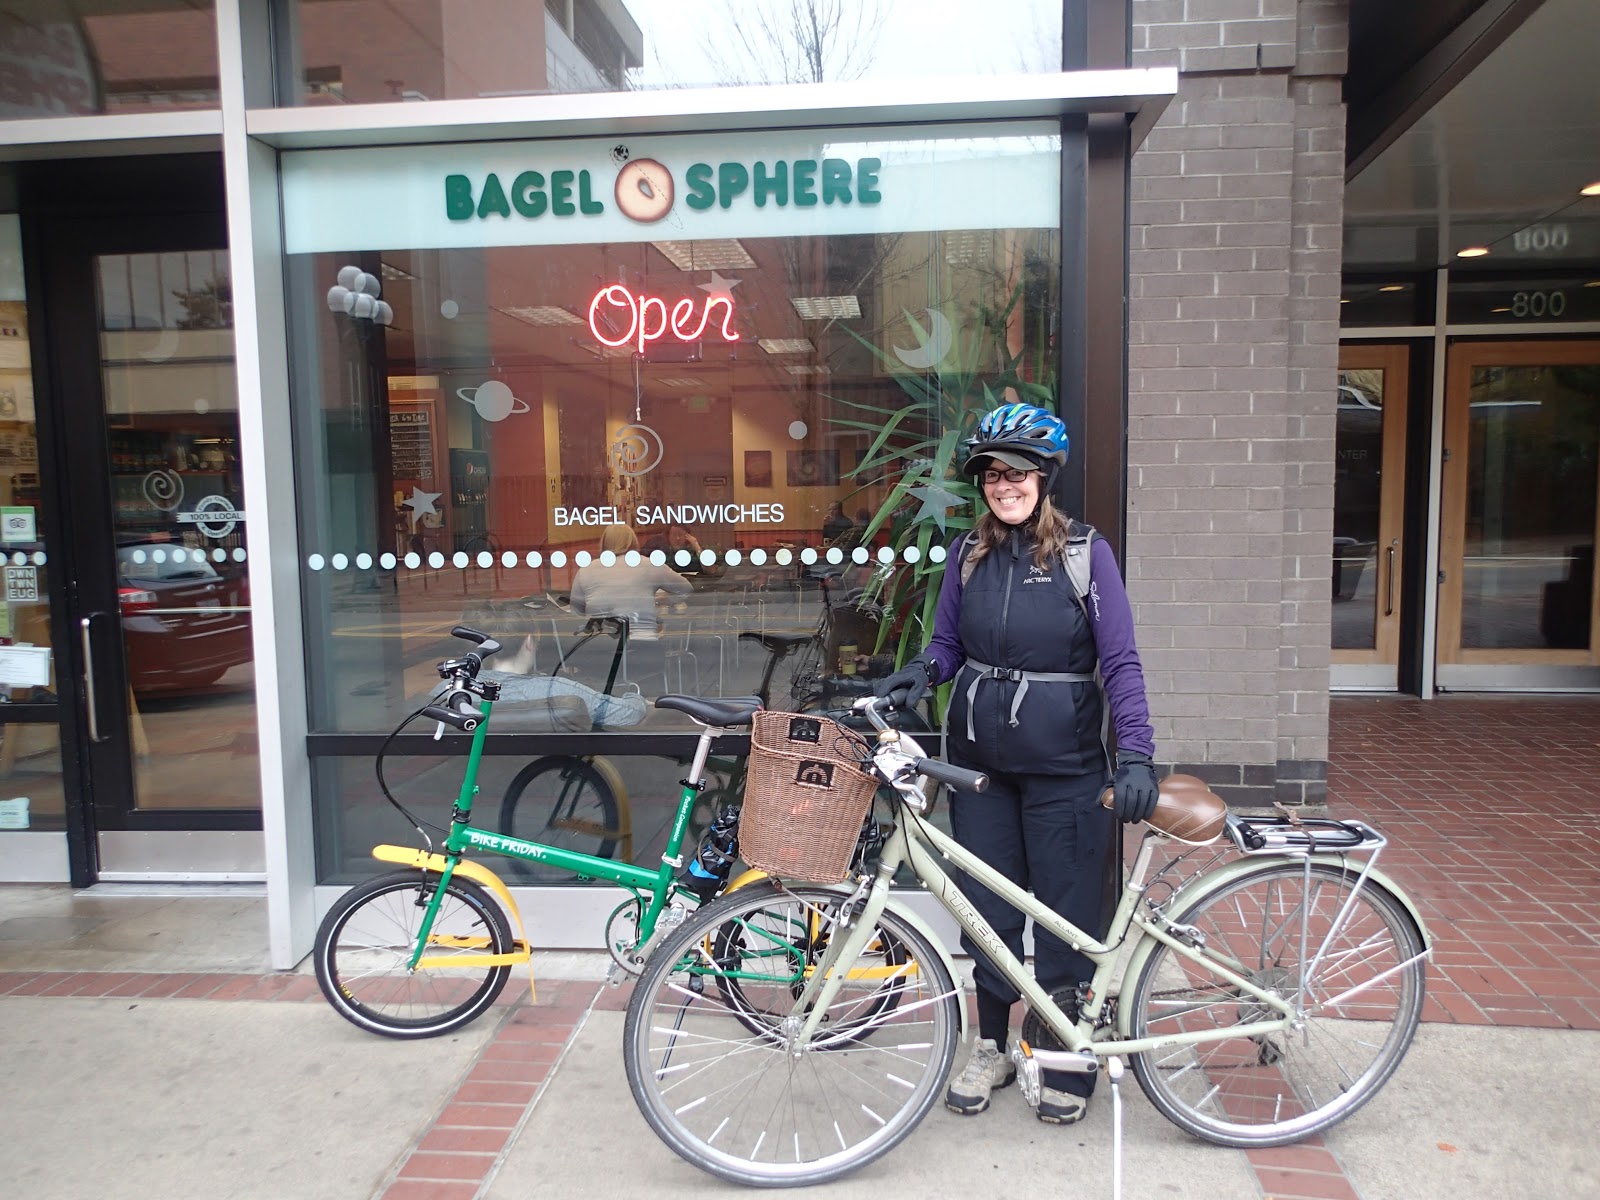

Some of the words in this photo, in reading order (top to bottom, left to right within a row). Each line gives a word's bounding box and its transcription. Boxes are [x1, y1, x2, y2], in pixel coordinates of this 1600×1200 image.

[445, 169, 603, 220] BAGEL
[685, 157, 882, 210] SPHERE
[1512, 291, 1565, 317] 800
[588, 284, 740, 353] Open
[1337, 449, 1369, 460] NTER
[189, 513, 211, 521] 100%
[214, 512, 242, 520] LOCAL
[554, 506, 625, 526] BAGEL
[635, 503, 785, 525] SANDWICHES
[8, 569, 34, 579] DWN
[8, 579, 34, 588] TWN
[9, 589, 35, 598] EUG
[470, 832, 500, 849] BIKE
[950, 890, 1005, 954] TREK
[1054, 920, 1079, 939] ALLANT
